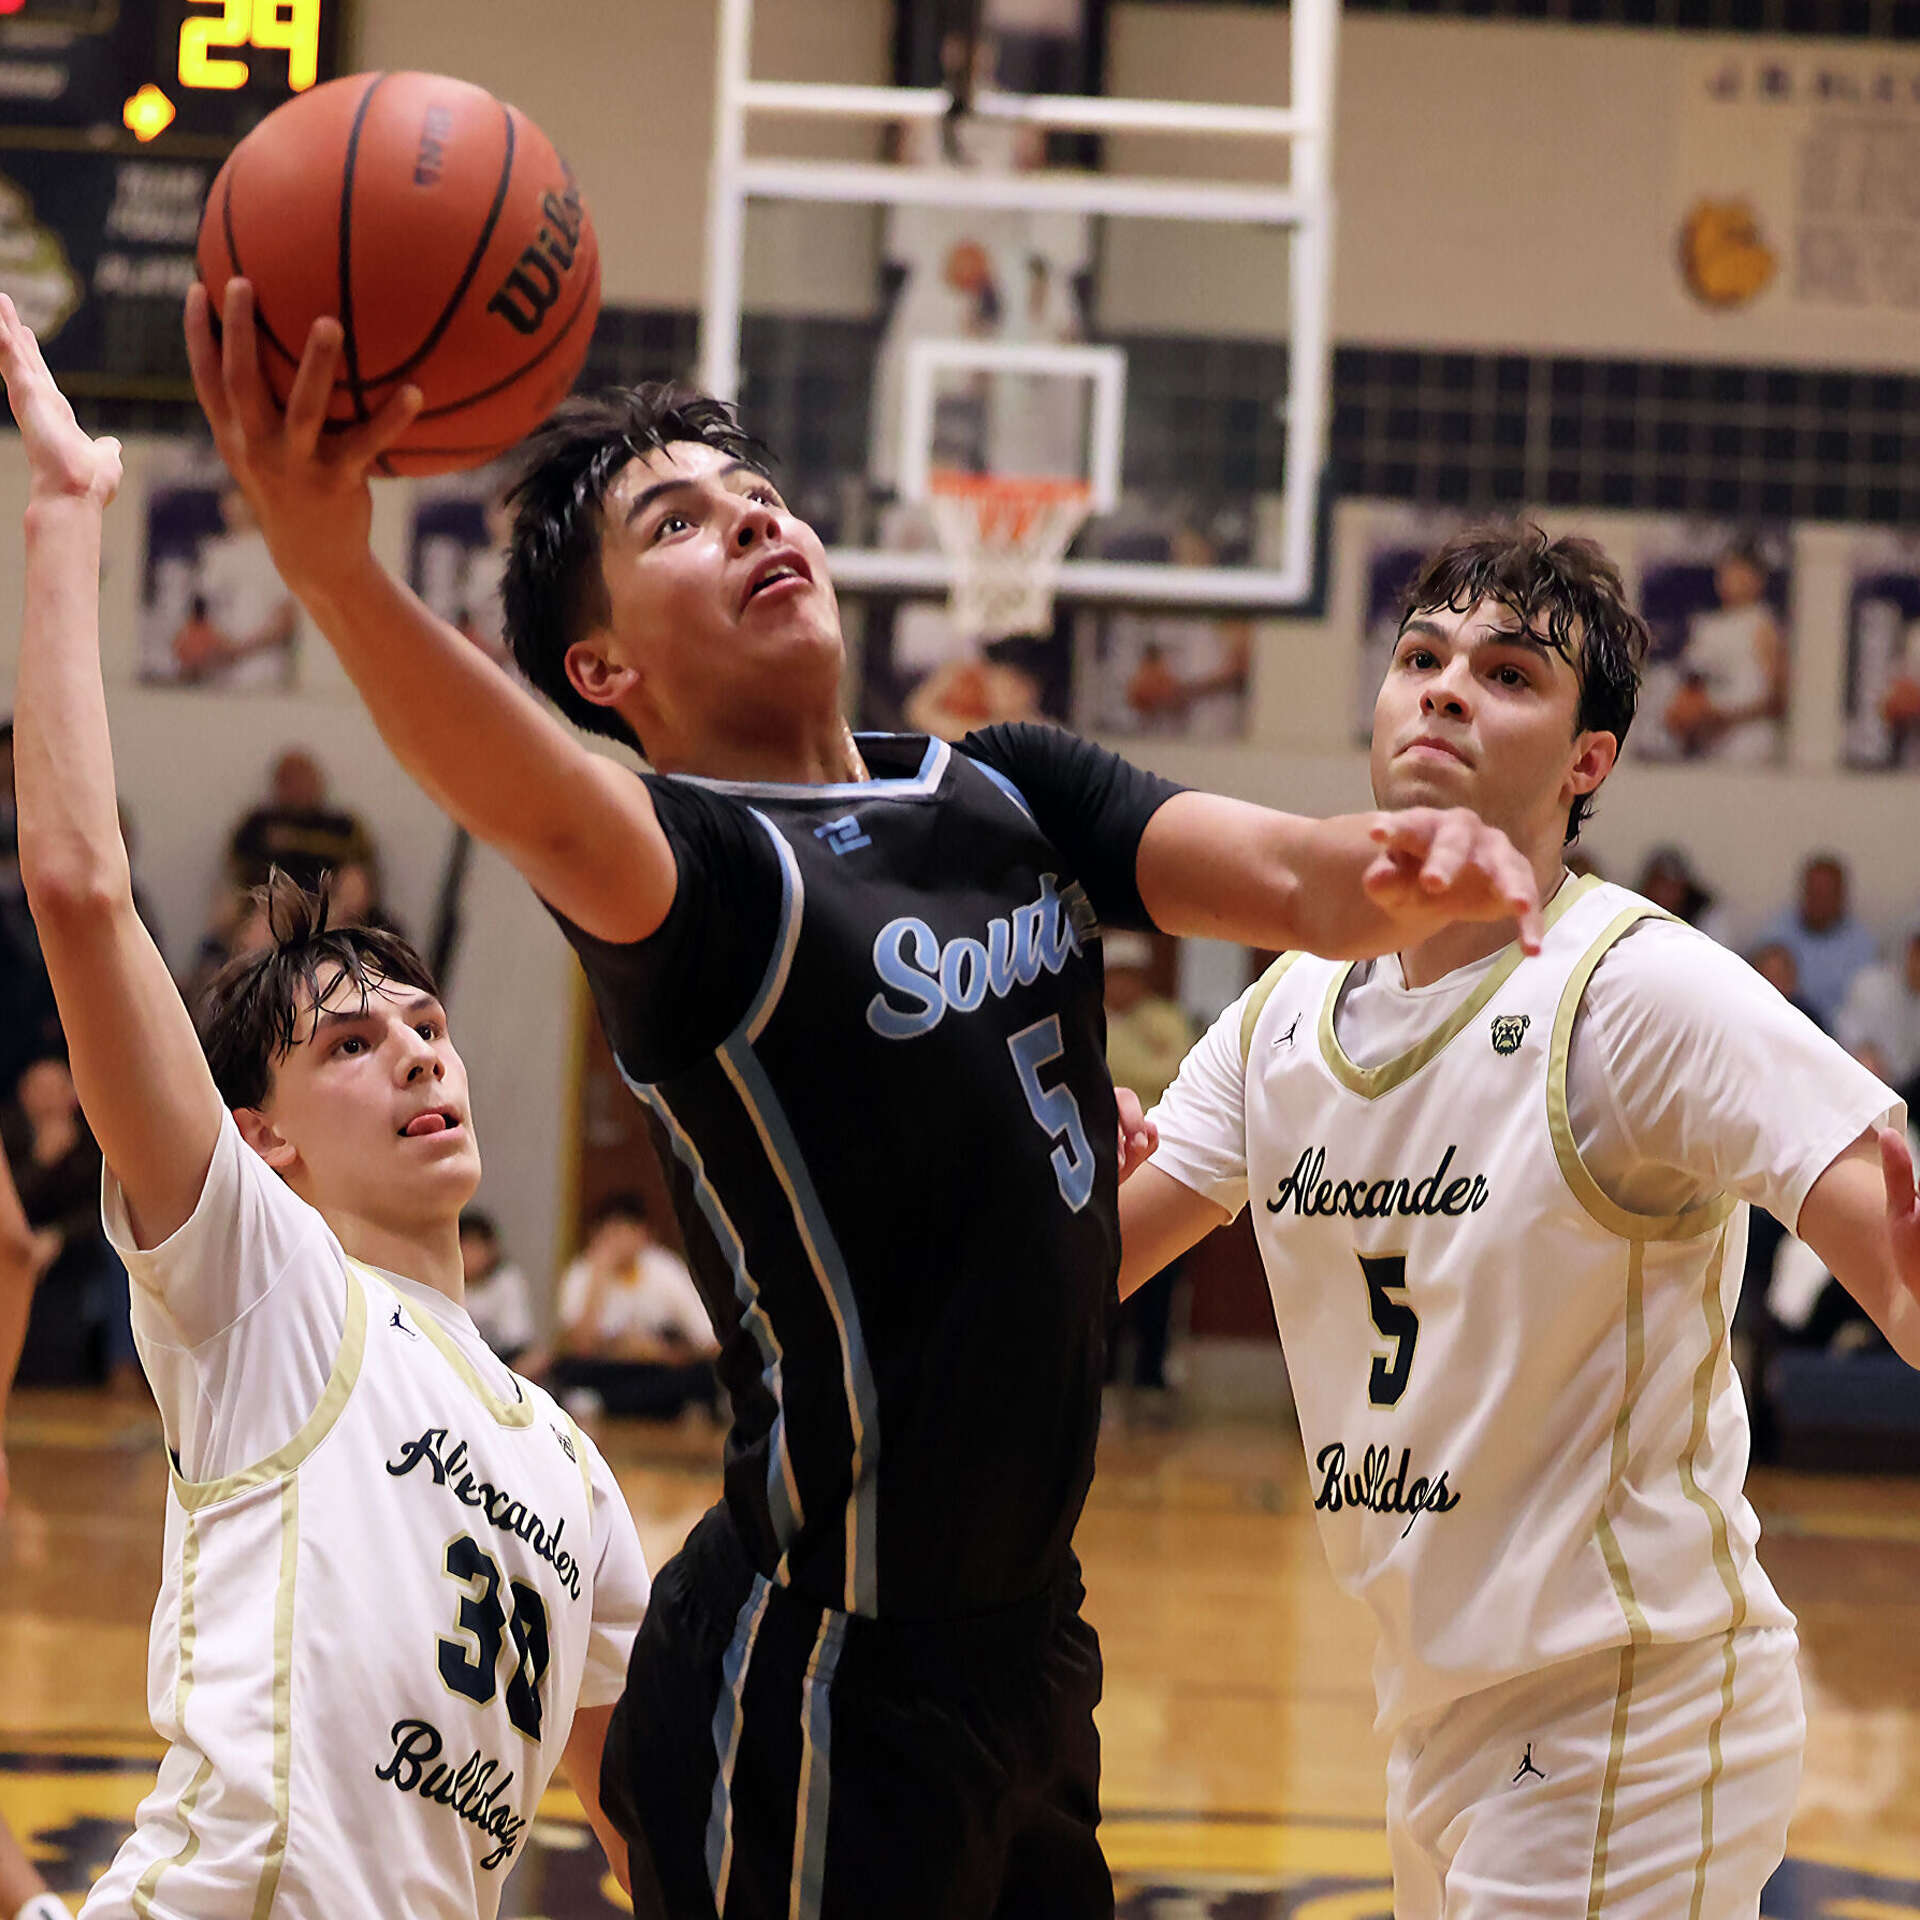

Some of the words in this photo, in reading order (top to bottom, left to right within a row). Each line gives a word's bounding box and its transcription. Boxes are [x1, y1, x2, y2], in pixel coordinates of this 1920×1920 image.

[178, 0, 321, 92] 29
[487, 158, 584, 335] Wil
[1006, 1012, 1096, 1214] 5
[1267, 1145, 1489, 1219] Alexander
[1353, 1248, 1421, 1412] 5
[386, 1429, 580, 1600] Alexander
[435, 1529, 550, 1744] 30
